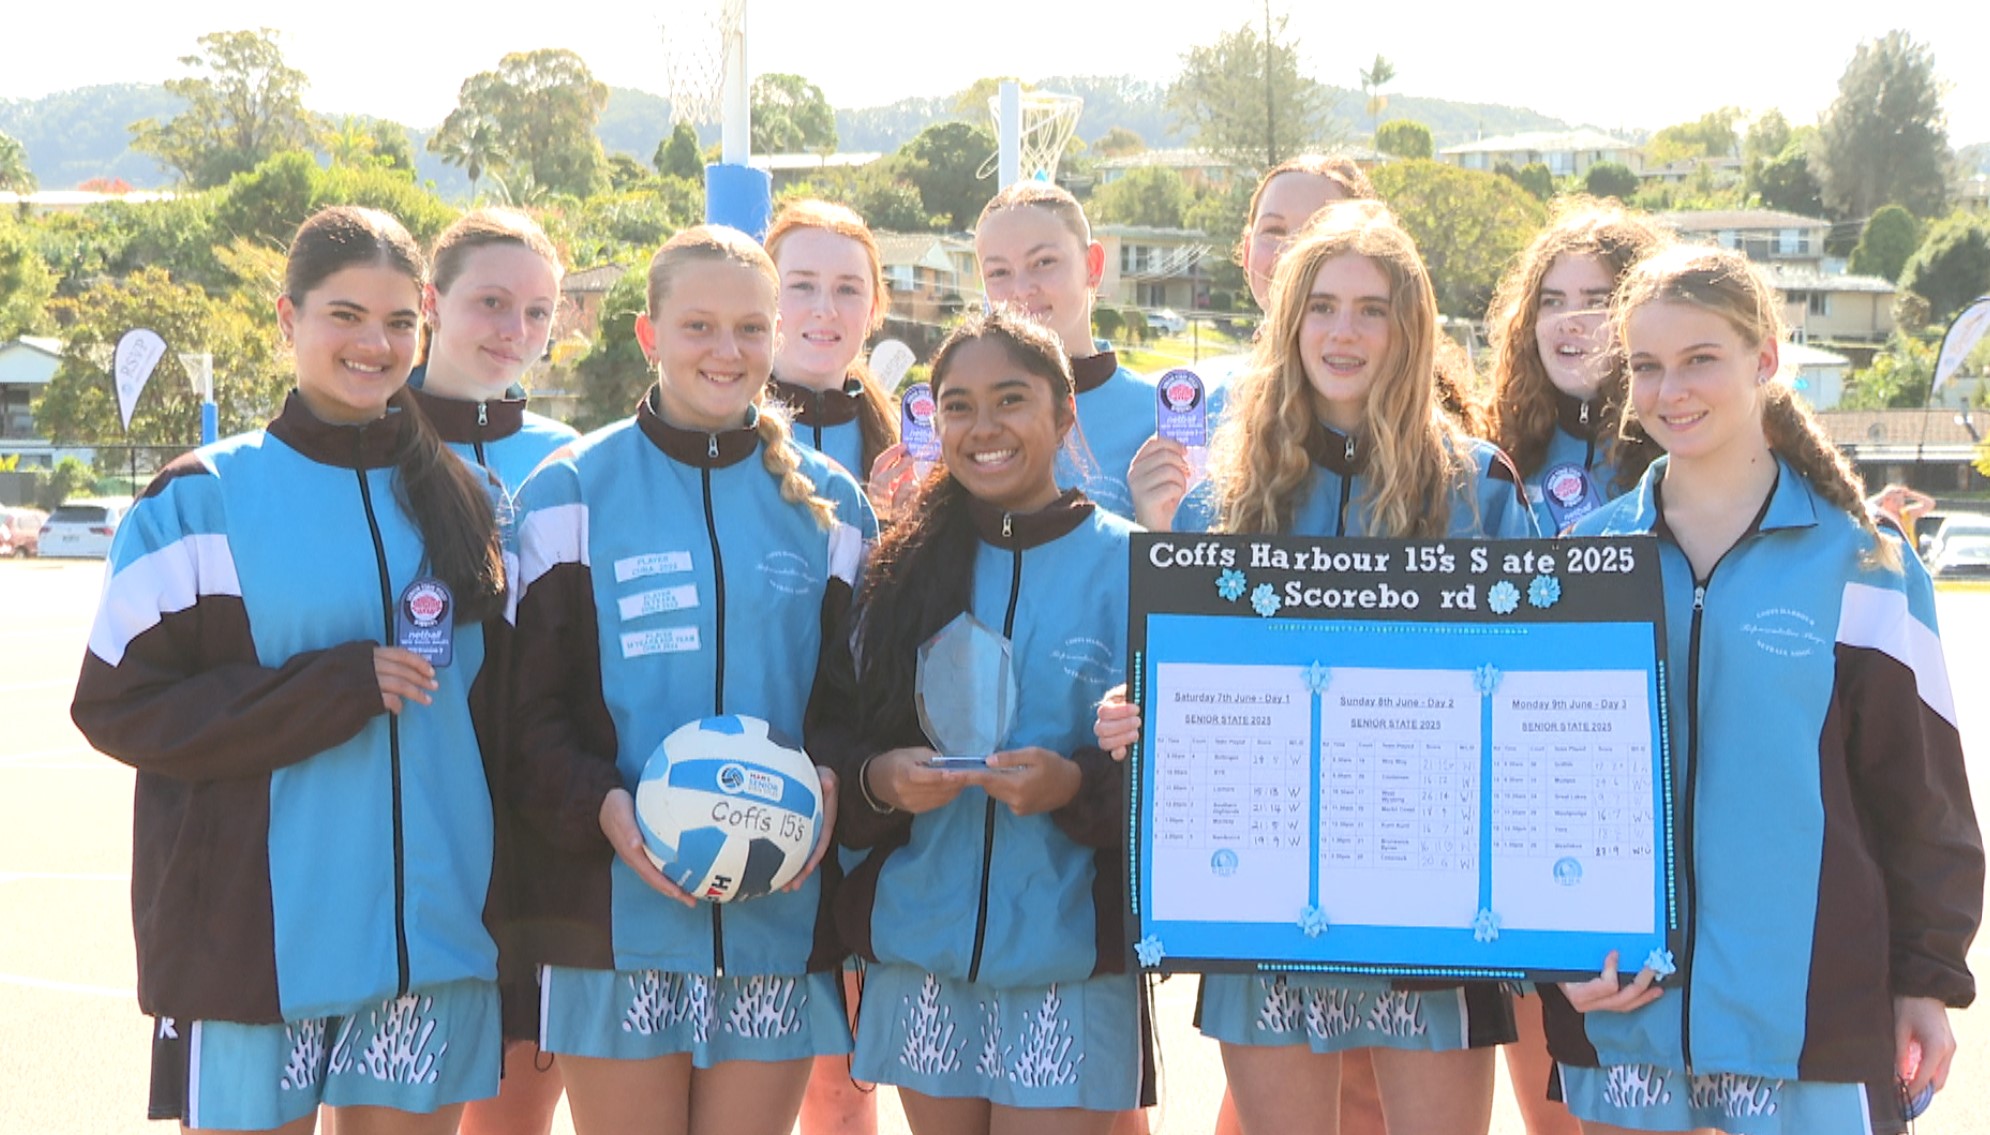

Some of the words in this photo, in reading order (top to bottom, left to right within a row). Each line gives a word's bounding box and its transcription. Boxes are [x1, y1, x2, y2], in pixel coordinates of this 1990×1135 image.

[1150, 543, 1235, 569] Coffs
[1250, 543, 1390, 573] Harbour
[1405, 545, 1456, 573] 15's
[1567, 546, 1635, 573] 2025
[408, 629, 442, 639] netball
[1175, 692, 1215, 704] Saturday
[1217, 692, 1232, 702] 7th
[1234, 693, 1257, 703] June
[1265, 694, 1282, 704] Day
[1340, 696, 1375, 707] Sunday
[1378, 697, 1393, 707] 8th
[1396, 697, 1419, 707] June
[1427, 698, 1446, 708] Day
[1448, 699, 1455, 708] 2
[1512, 699, 1549, 710] Monday
[1552, 699, 1567, 709] 9th
[1569, 700, 1593, 709] June
[1601, 700, 1619, 710] Day
[1621, 700, 1627, 710] 3
[1185, 714, 1218, 725] SENIOR
[1221, 715, 1249, 726] STATE
[1251, 715, 1271, 726] 2025
[1351, 718, 1387, 728] SENIOR
[1389, 719, 1418, 730] STATE
[1419, 720, 1441, 730] 2025
[1522, 722, 1558, 732] SENIOR
[1560, 723, 1590, 732] STATE
[1591, 723, 1612, 732] 2025
[1290, 755, 1301, 766] W
[1288, 786, 1301, 798] W
[1289, 802, 1300, 813] W
[712, 801, 771, 832] Coffs
[780, 813, 805, 842] 15's
[1288, 820, 1299, 831] W
[1288, 835, 1301, 847] W
